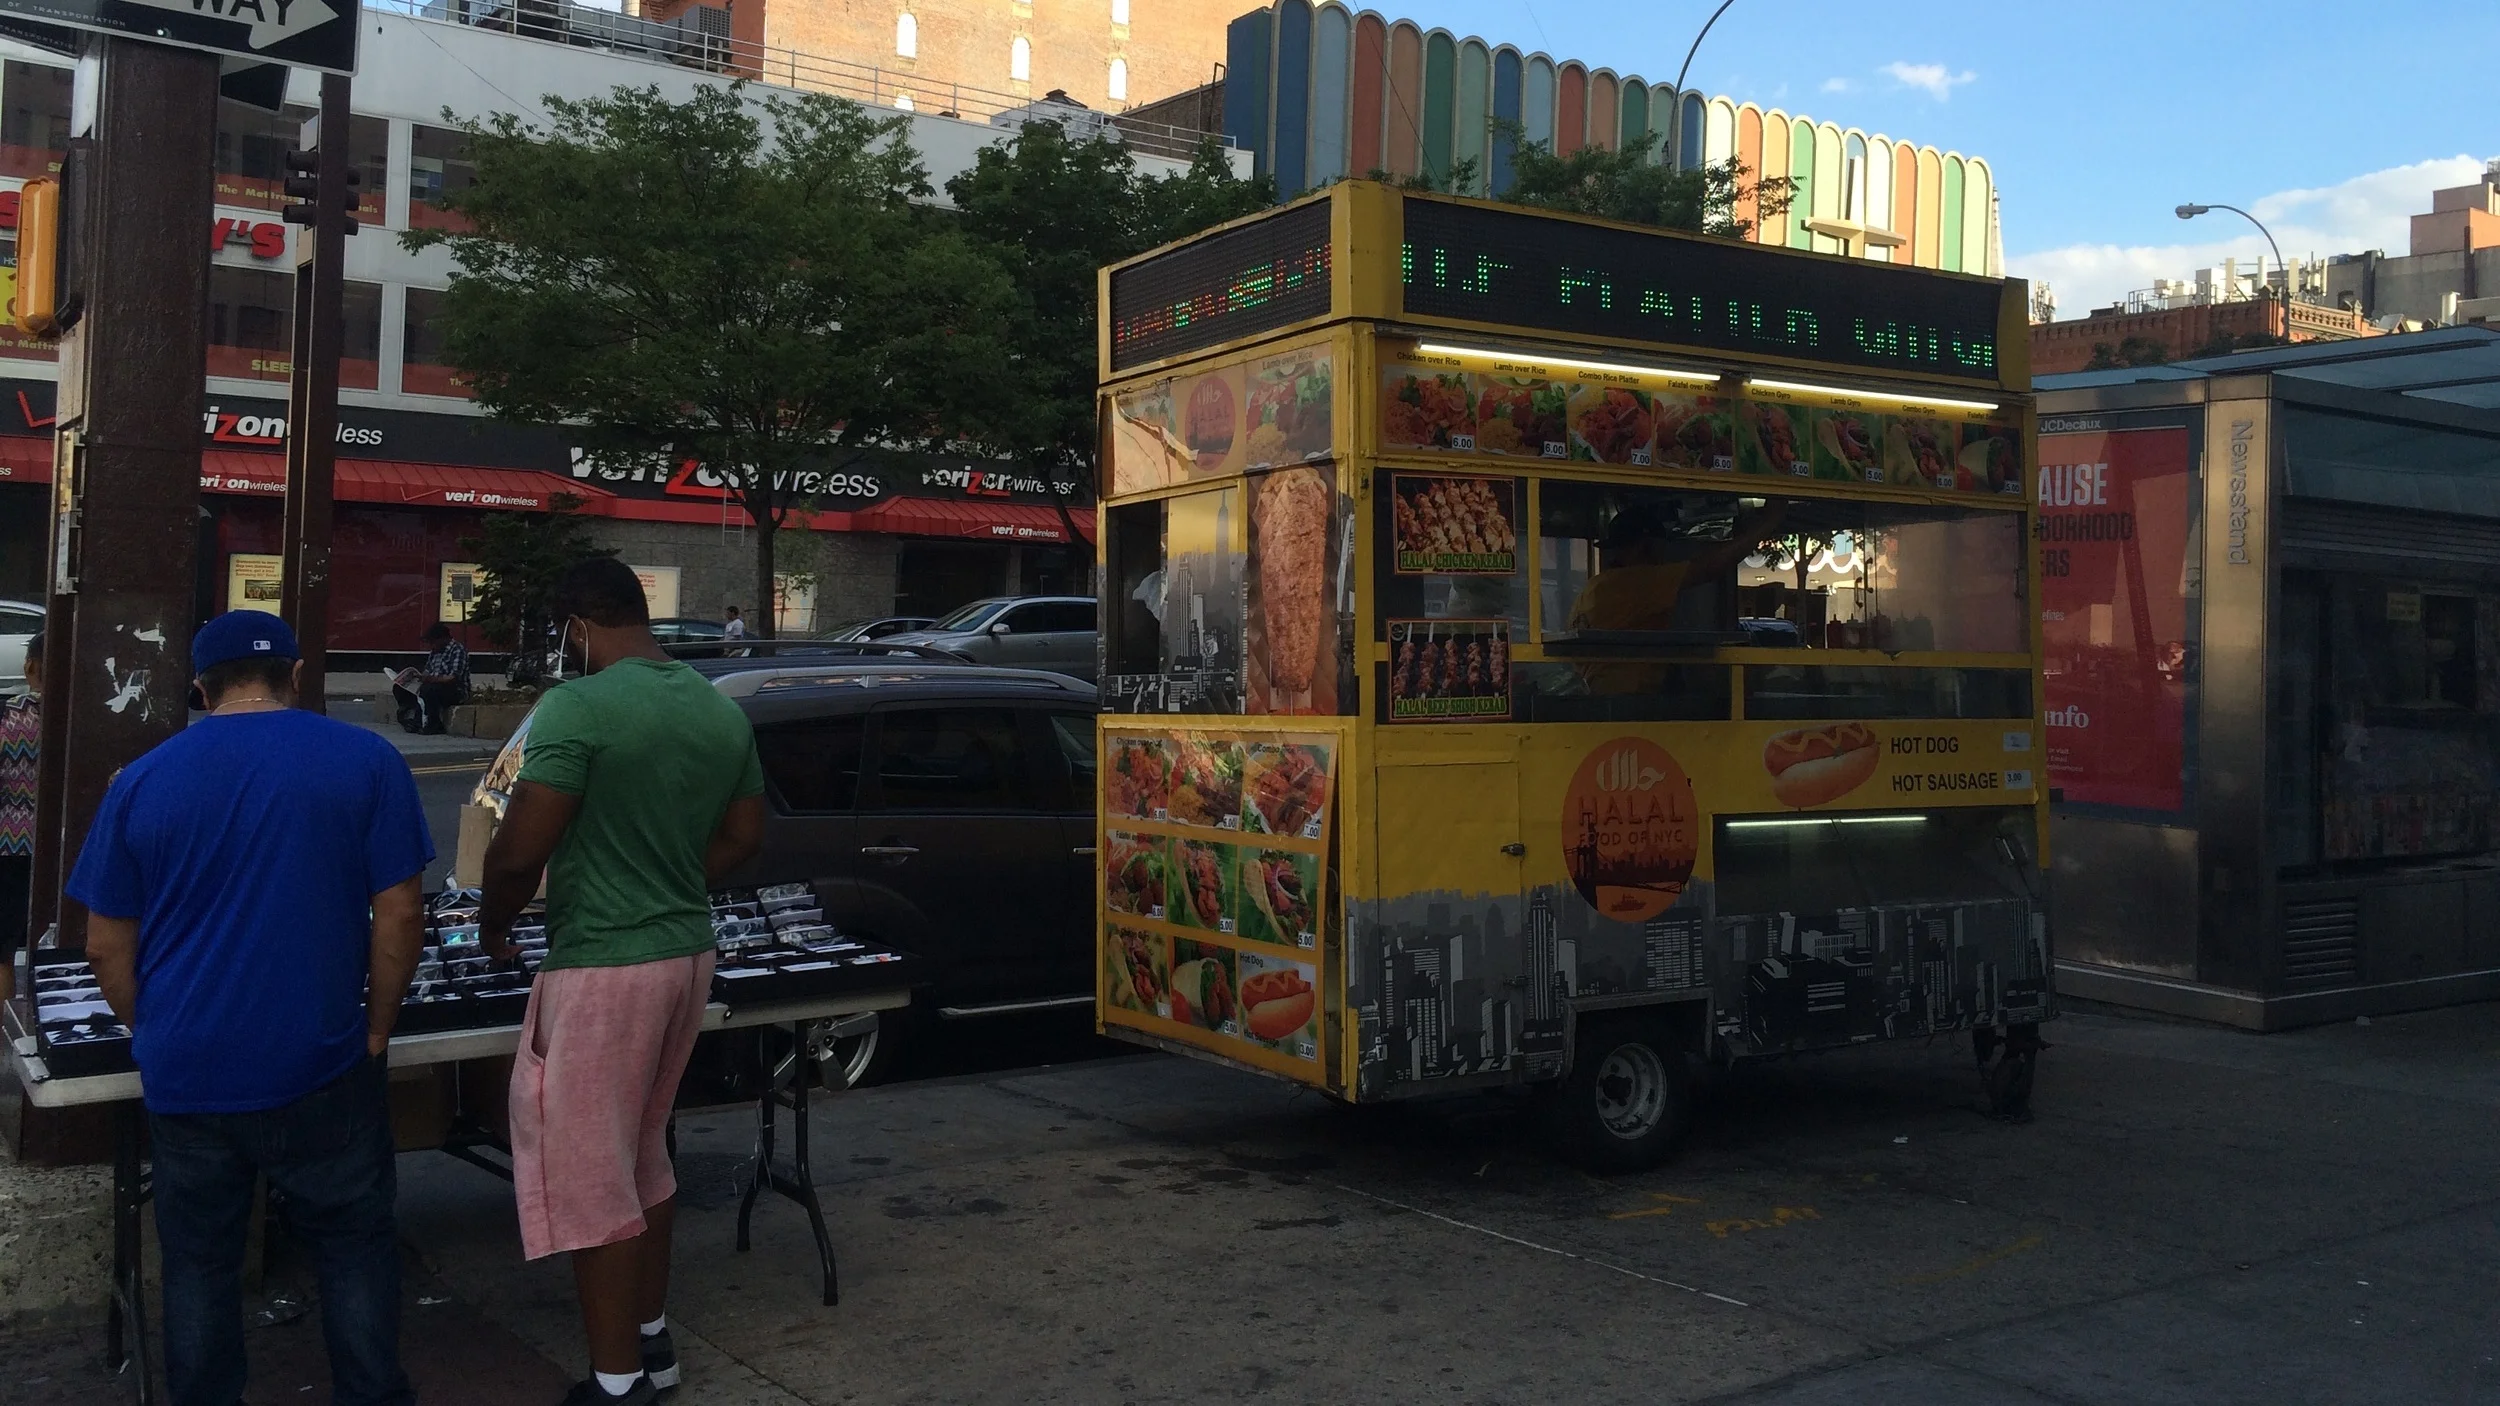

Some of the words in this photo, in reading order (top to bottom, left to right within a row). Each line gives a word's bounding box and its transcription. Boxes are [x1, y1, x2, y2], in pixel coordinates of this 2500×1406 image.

[33, 5, 126, 27] TRANSPORTATION
[217, 183, 239, 195] The
[0, 336, 14, 347] he
[1397, 351, 1426, 363] Chicken
[1428, 356, 1444, 364] over
[1445, 357, 1461, 366] Rice
[1494, 361, 1513, 371] Lamb
[1515, 365, 1531, 373] over
[1532, 366, 1547, 375] Rice
[1578, 370, 1602, 381] Combo
[1603, 374, 1618, 382] Rice
[1619, 375, 1640, 385] Platter
[1667, 380, 1689, 389] Falafel
[1751, 388, 1775, 398] Chicken
[1776, 391, 1791, 400] Gyro
[1830, 397, 1846, 405] Lamb
[1847, 399, 1861, 407] Gyro
[2040, 419, 2101, 433] JCDecaux
[1453, 437, 1472, 449] 6.00
[1545, 442, 1564, 455] 6.00
[1632, 453, 1650, 465] 7.00
[1714, 458, 1732, 469] 6.00
[1792, 464, 1808, 475] 5.00
[1867, 470, 1883, 481] 5.00
[2005, 483, 2020, 492] 5.00
[2229, 420, 2254, 565] Newsstand
[1402, 551, 1433, 568] HALAL
[1435, 552, 1478, 568] CHICKEN
[1480, 553, 1513, 569] KEBAB
[1395, 699, 1425, 716] HALAL
[1450, 697, 1476, 714] SHISH
[1477, 696, 1507, 714] KEBAB
[1891, 738, 1922, 754] HOT
[1926, 737, 1959, 753] DOG
[1892, 775, 1922, 791] HOT
[1928, 773, 1998, 790] SAUSAGE
[2007, 773, 2022, 782] 3.00
[1579, 795, 1684, 826] HALAL
[1628, 831, 1648, 845] OF
[1654, 829, 1683, 843] NYC
[1220, 918, 1233, 930] 5.00
[1298, 933, 1313, 945] 5.00
[1240, 953, 1251, 963] Hot
[1252, 955, 1264, 968] Dog
[1300, 1044, 1315, 1056] 3.00
